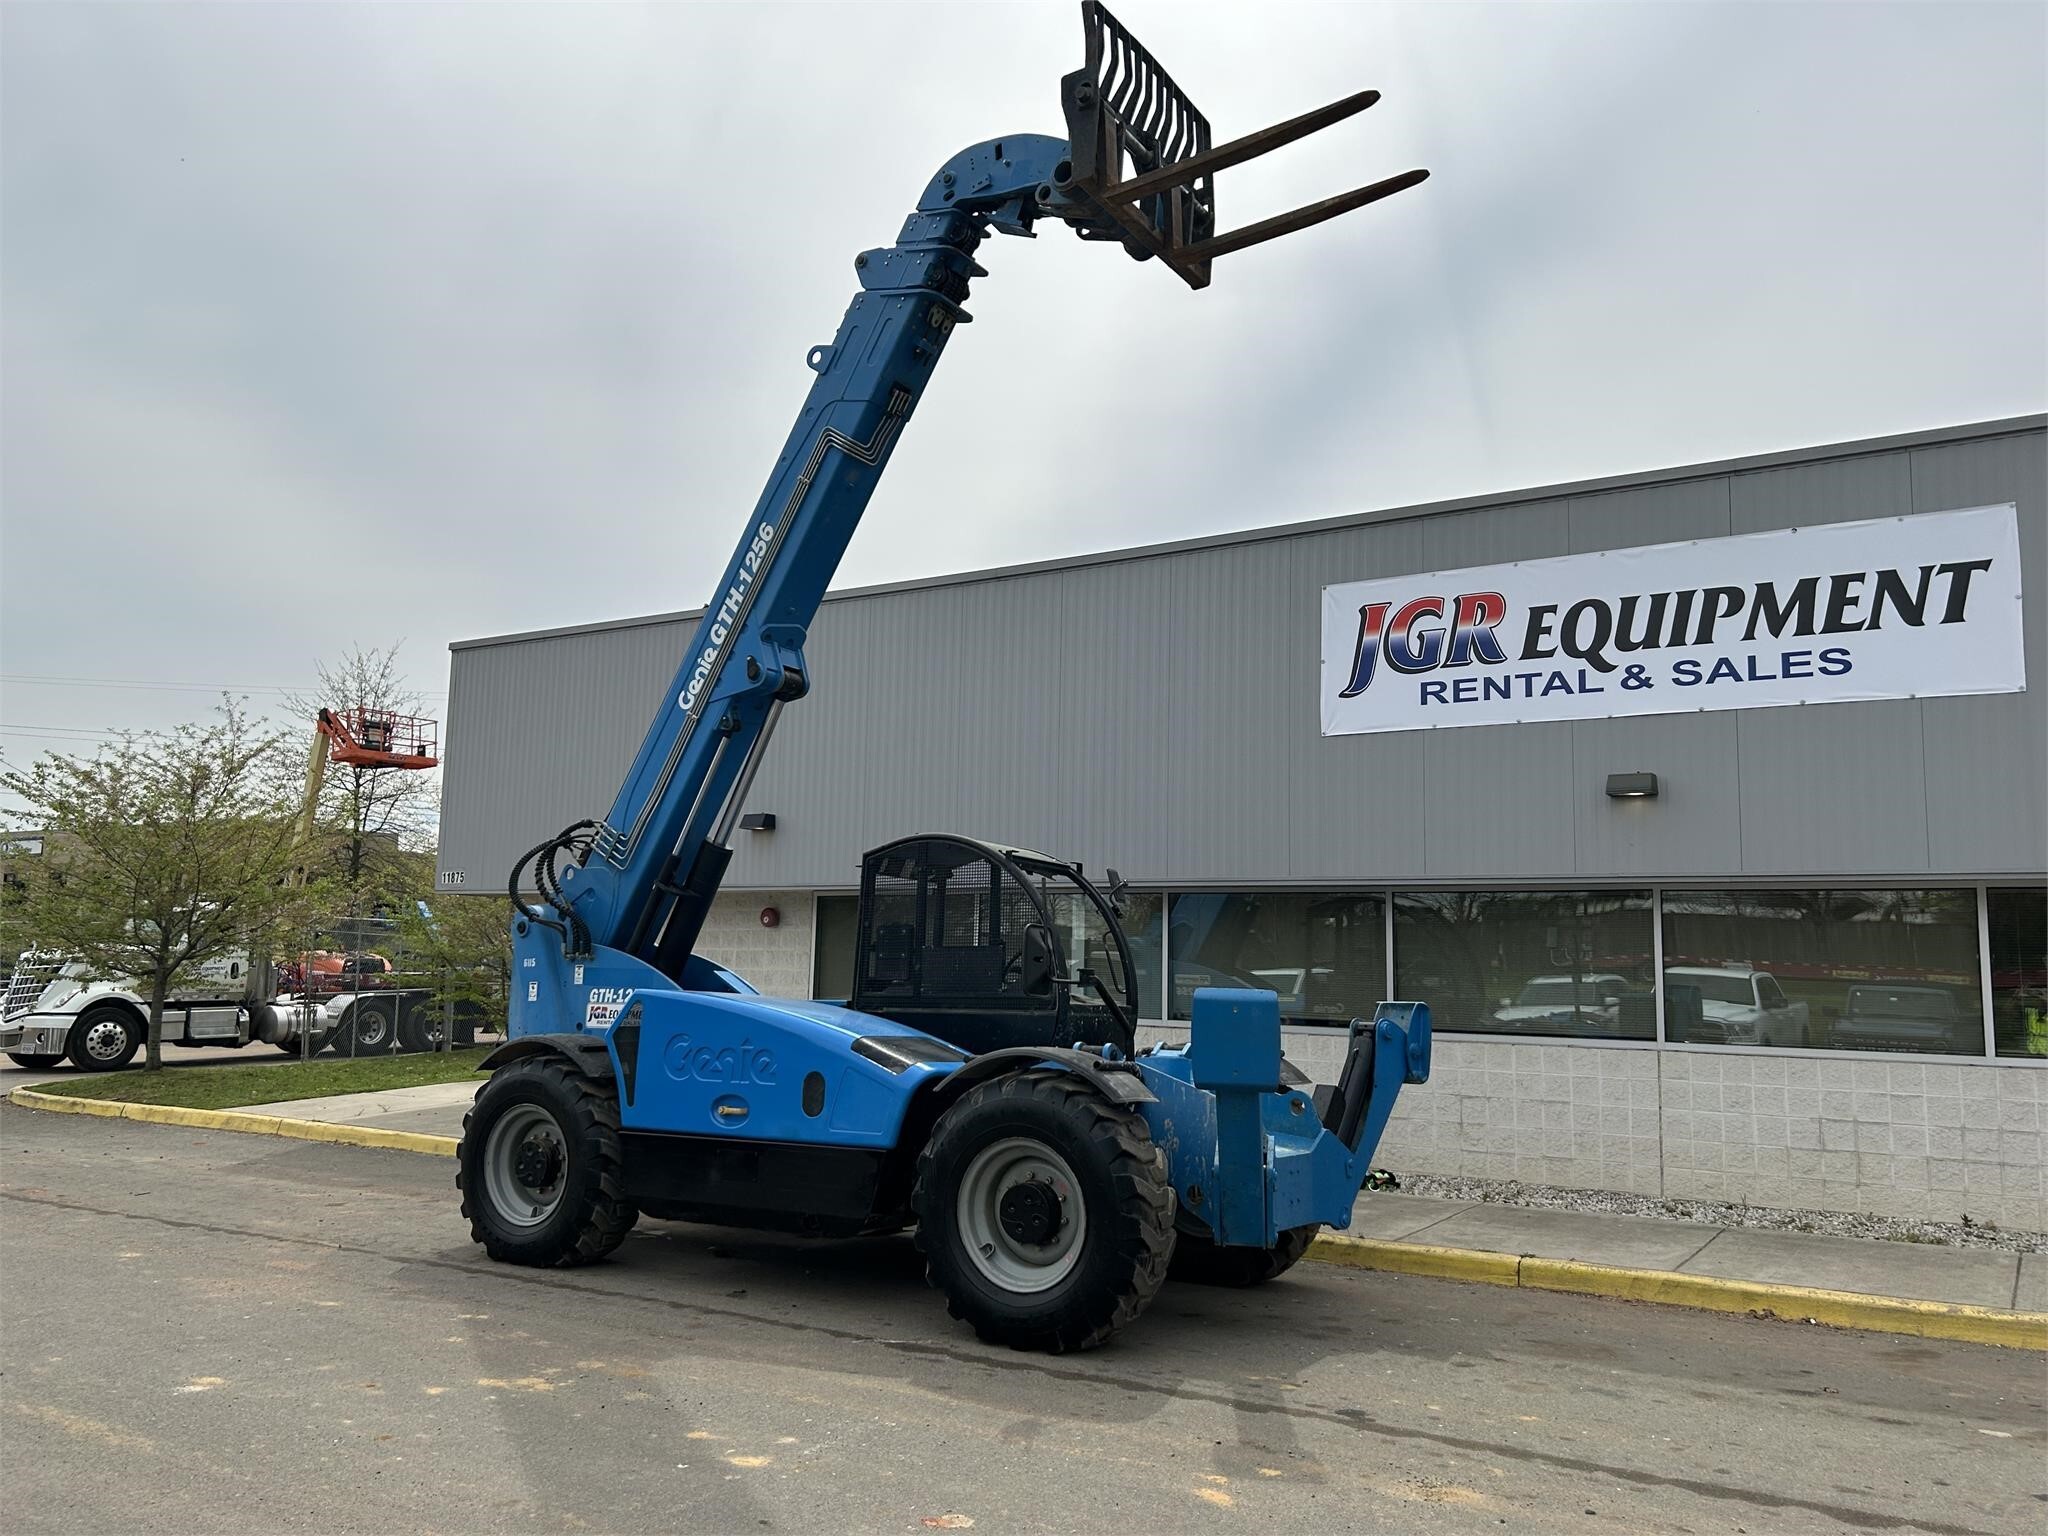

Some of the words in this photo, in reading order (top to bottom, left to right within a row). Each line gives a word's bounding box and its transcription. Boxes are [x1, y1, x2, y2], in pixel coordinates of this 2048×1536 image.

[678, 647, 719, 710] Genie
[710, 522, 775, 645] GTH-1256
[1338, 591, 1508, 700] JGR
[1518, 558, 1994, 673] EQUIPMENT
[1420, 668, 1605, 707] RENTAL
[1622, 663, 1654, 690] &
[1672, 647, 1853, 686] SALES
[442, 871, 465, 884] 11875
[588, 1006, 608, 1022] JGR
[589, 988, 633, 1003] GTH-12
[664, 1032, 778, 1086] Genie
